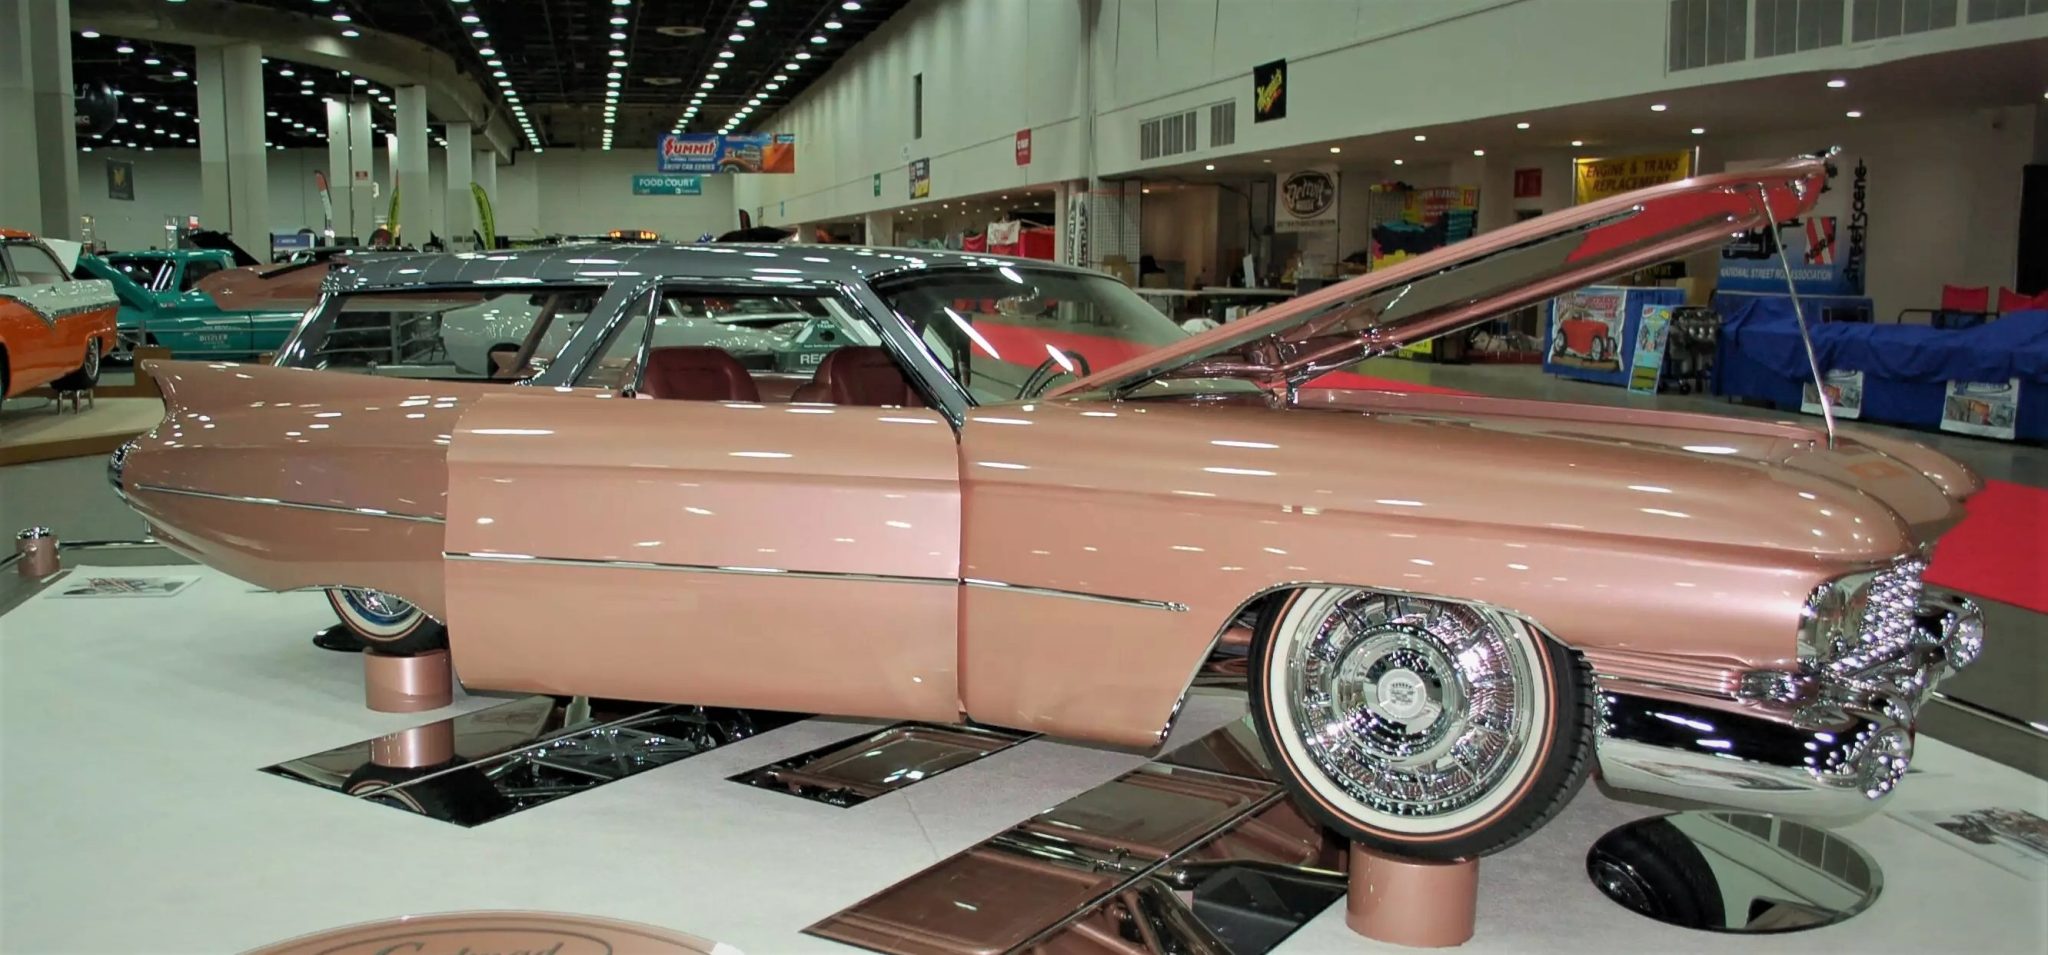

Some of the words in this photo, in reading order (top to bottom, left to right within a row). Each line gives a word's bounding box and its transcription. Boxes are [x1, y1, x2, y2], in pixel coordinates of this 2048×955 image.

[664, 137, 716, 157] SUMMIT
[1586, 163, 1624, 178] ENGINE
[1644, 157, 1680, 172] TRANS
[639, 178, 663, 187] FOOD
[665, 178, 694, 187] COURT
